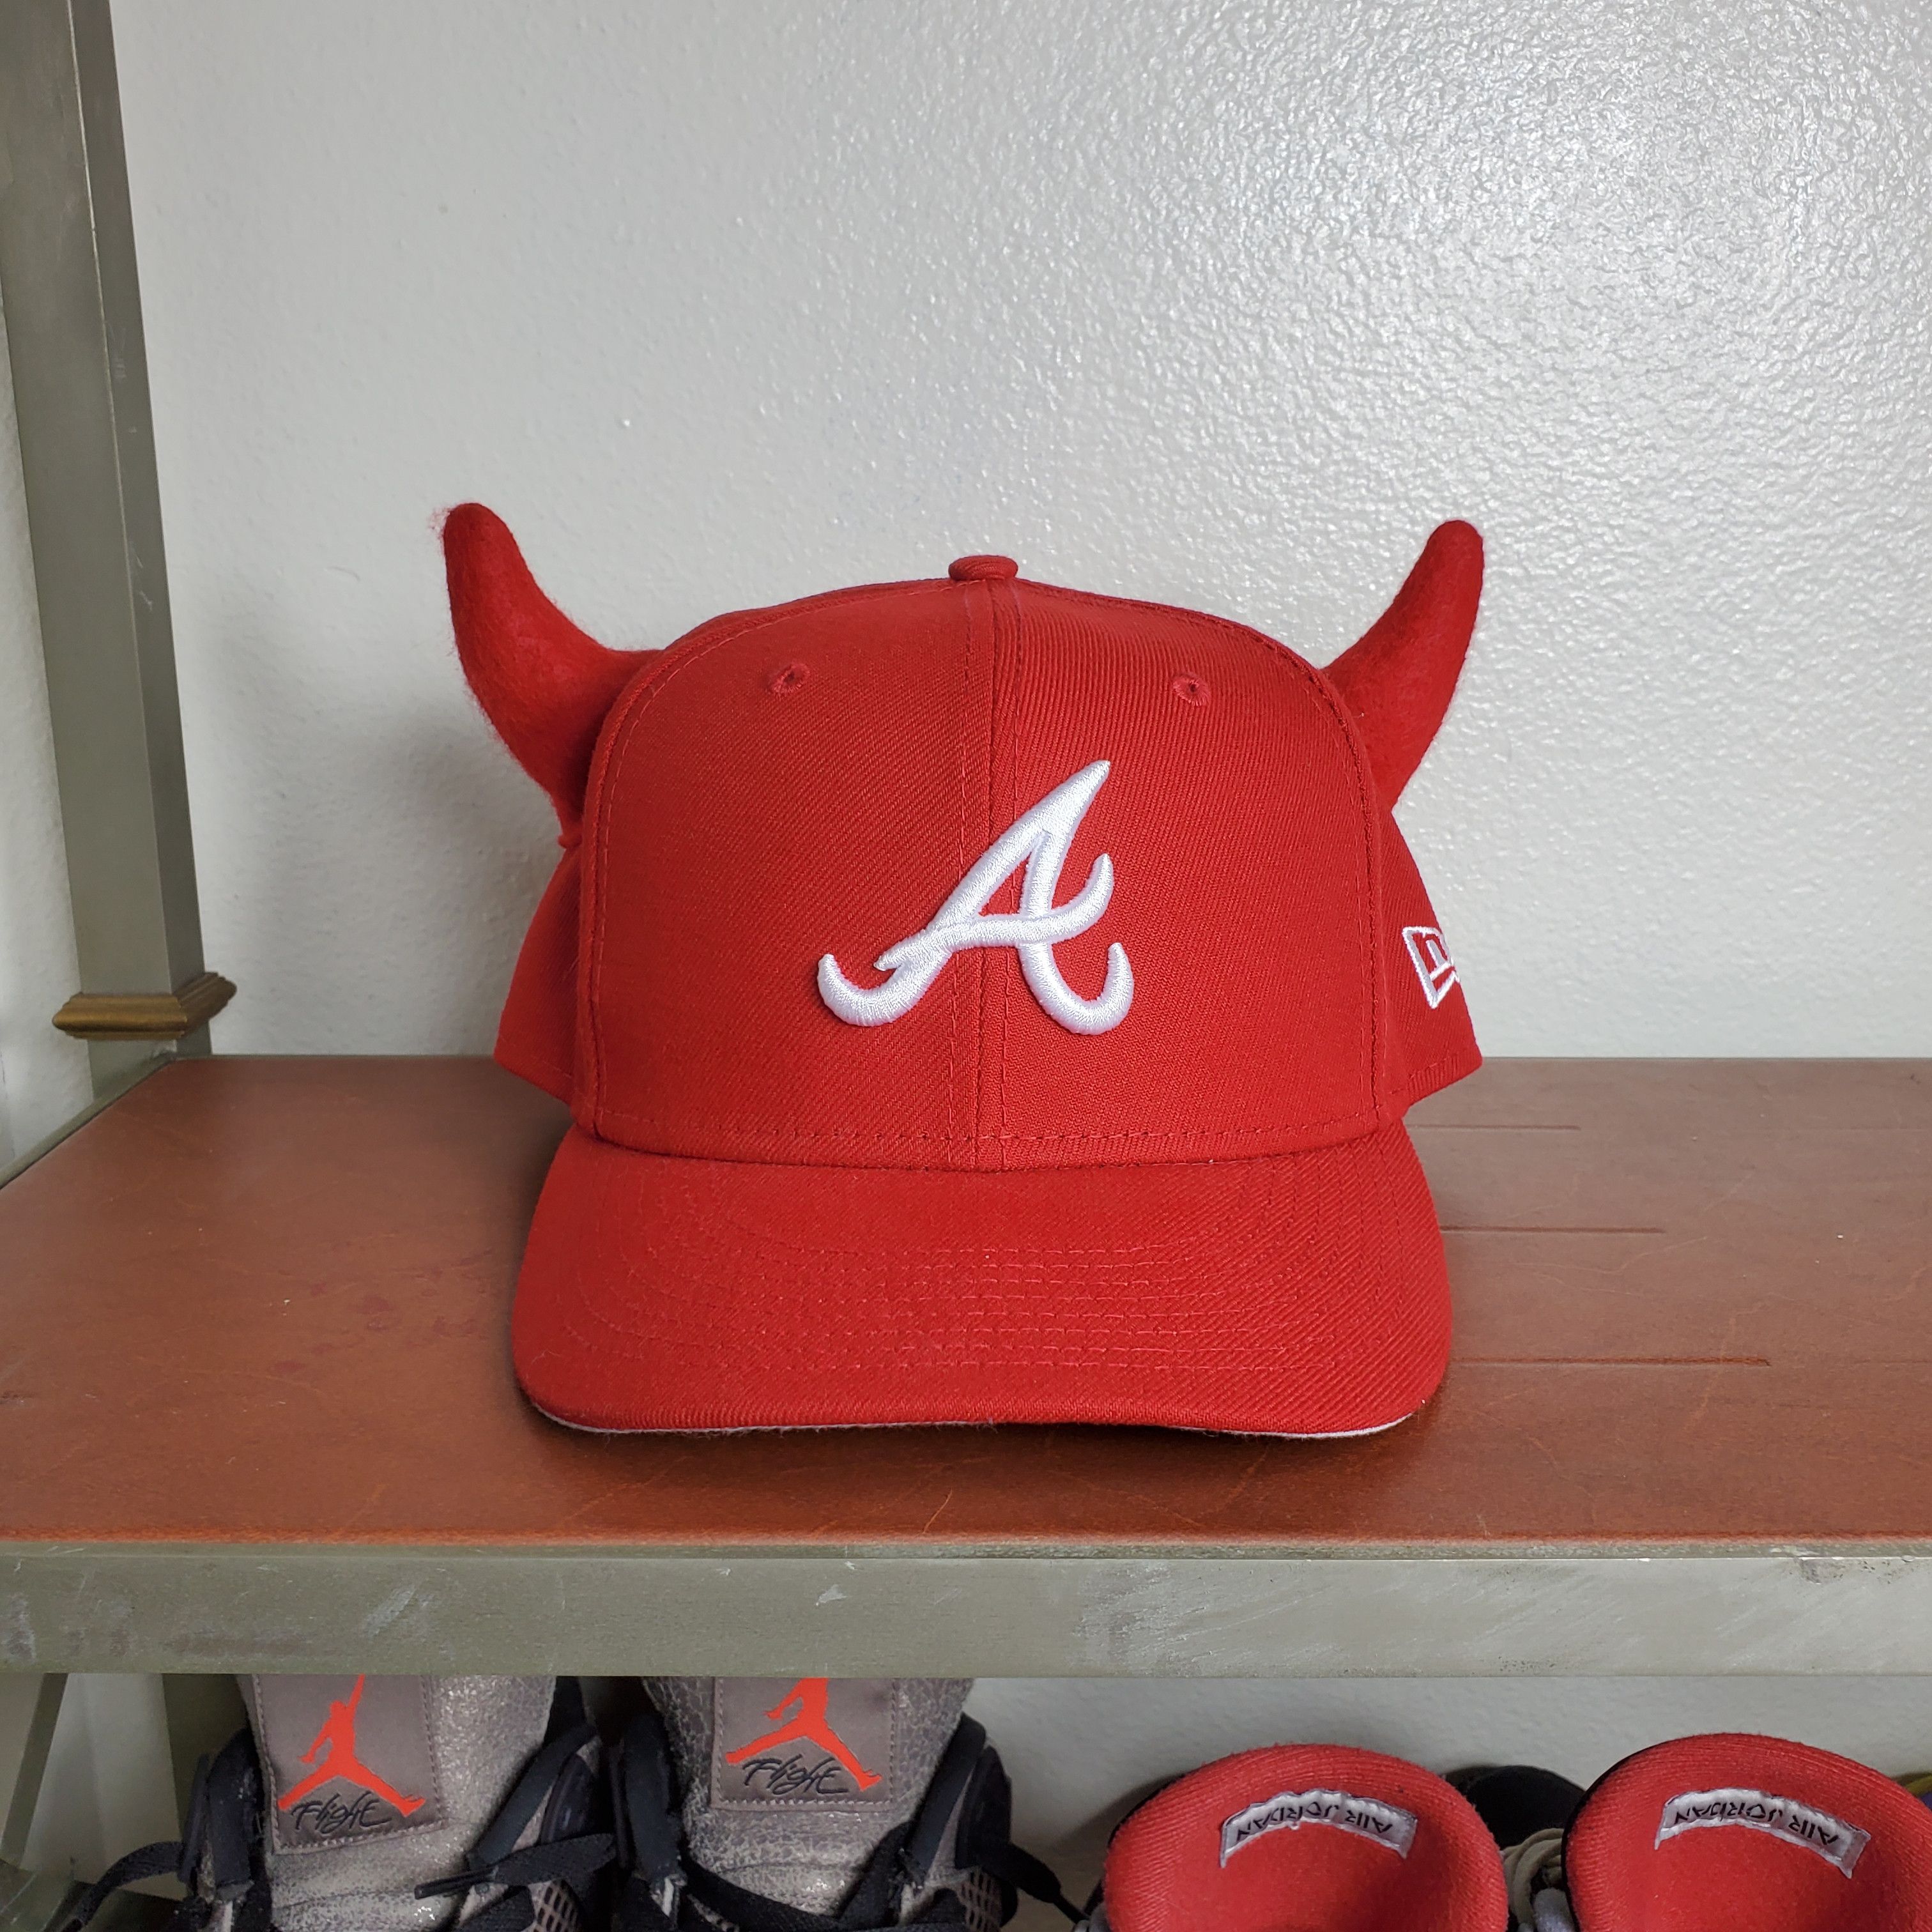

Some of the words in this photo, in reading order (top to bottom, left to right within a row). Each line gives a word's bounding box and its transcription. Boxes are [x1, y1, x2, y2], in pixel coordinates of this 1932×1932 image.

[818, 760, 1134, 1036] A
[742, 1754, 849, 1795] Flight
[290, 1791, 392, 1834] Flight
[1237, 1801, 1339, 1841] JORDAN
[1344, 1810, 1393, 1834] AIR
[1675, 1802, 1782, 1824] JORDAN
[1789, 1814, 1838, 1845] AIR
